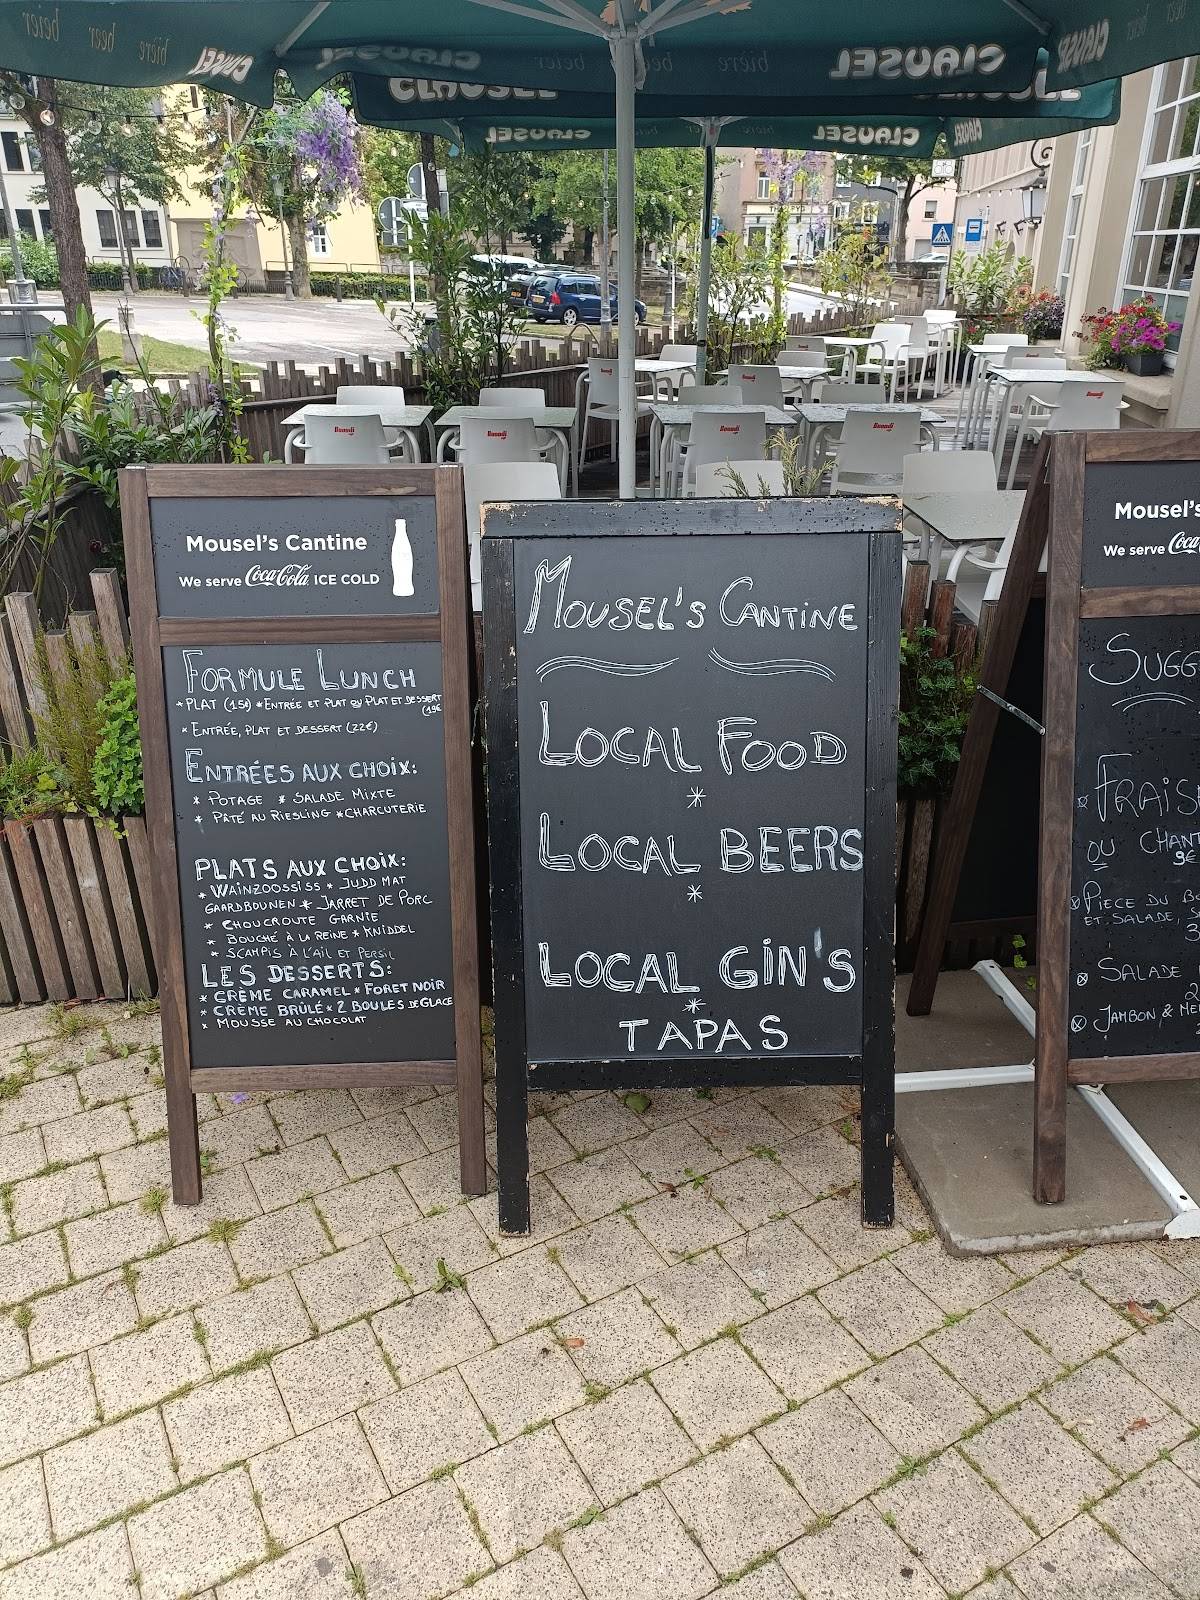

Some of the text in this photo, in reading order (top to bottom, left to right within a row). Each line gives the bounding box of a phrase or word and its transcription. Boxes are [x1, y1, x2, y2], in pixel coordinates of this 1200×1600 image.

[187, 534, 367, 551] Mousel’s Cantine
[1103, 544, 1126, 557] We
[1129, 545, 1166, 556] serve
[179, 564, 379, 587] We serve Coca-Cola ICE COLD
[183, 649, 415, 693] FORMULE LUNCH
[186, 698, 216, 711] PLAT
[264, 698, 302, 710] ENTRÉE
[308, 700, 319, 708] ET
[324, 698, 346, 707] PLAT
[365, 695, 388, 706] PLAT
[391, 697, 402, 705] ET
[191, 721, 377, 738] ENTRÉE, PLAT ET DESSERT (22€)
[539, 701, 846, 775] LOCAL FOOD
[185, 749, 294, 784] ENTRÉES
[303, 763, 342, 782] AUX
[208, 791, 262, 805] POTAGE
[293, 792, 344, 803] SALADE
[212, 811, 244, 823] PÂTÉ
[252, 814, 265, 822] AU
[539, 813, 863, 876] LOCAL BEERS
[1086, 838, 1116, 864] OU
[195, 858, 277, 880] PLATS
[287, 860, 326, 879] AUX
[339, 878, 376, 889] JUDD
[382, 876, 406, 886] MAT
[205, 889, 432, 914] GAARDBOUNEN JARRET DE PORC
[1145, 893, 1169, 907] DU
[1083, 915, 1100, 926] ET
[226, 931, 278, 944] BOUCHÉ
[287, 932, 294, 941] À
[299, 934, 310, 942] LA
[288, 943, 299, 958] À
[337, 949, 352, 959] ET
[202, 960, 391, 989] LES DESSERTS:
[538, 942, 700, 994] LOCAL
[1097, 957, 1183, 983] SALADE
[214, 987, 272, 1003] CRÈME
[283, 987, 351, 999] CARAMEL
[364, 983, 408, 995] FORET
[212, 1003, 269, 1017] CRÈME
[336, 1000, 348, 1014] 2
[351, 999, 406, 1013] BOULES
[407, 1000, 419, 1010] DE
[419, 995, 455, 1009] GLACE
[217, 1018, 276, 1028] MOUSSE
[307, 1016, 366, 1025] CHOCOLAT
[1093, 1004, 1156, 1033] JAMBON
[1161, 1003, 1174, 1018] &
[619, 1015, 788, 1053] TAPAS
